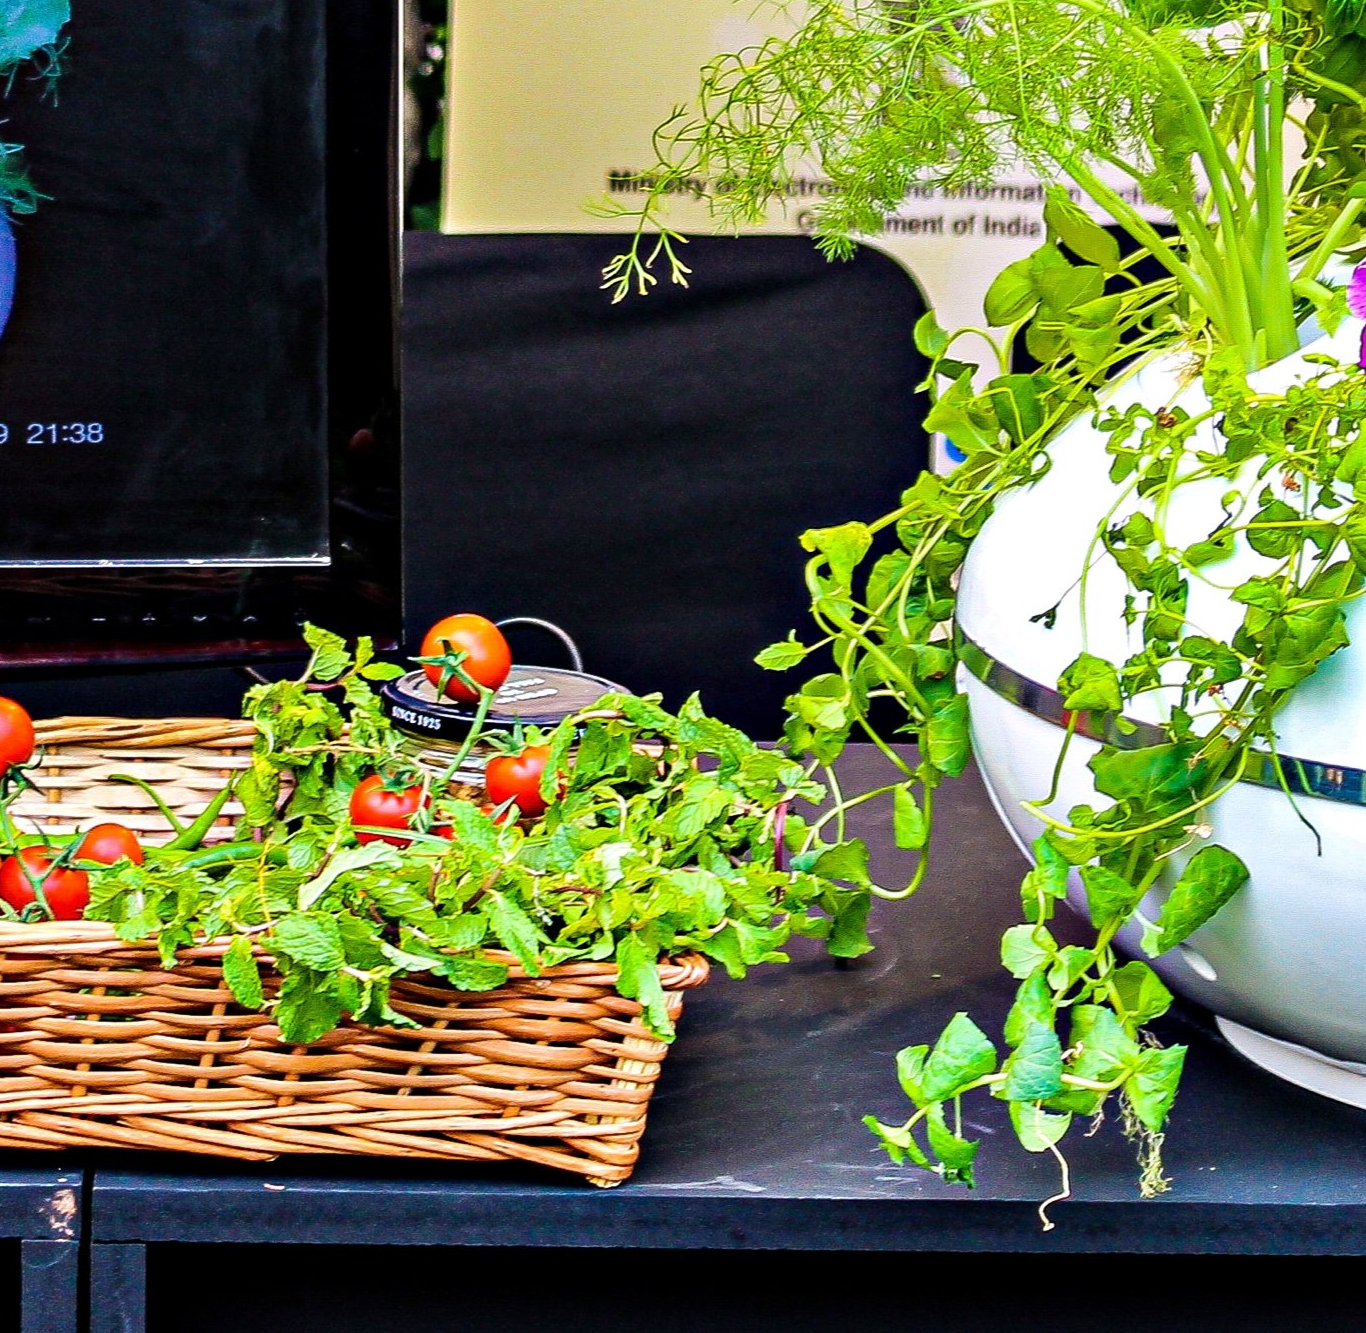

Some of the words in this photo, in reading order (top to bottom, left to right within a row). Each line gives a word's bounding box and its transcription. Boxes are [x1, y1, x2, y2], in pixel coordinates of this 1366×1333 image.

[953, 214, 975, 235] of
[984, 215, 1041, 237] India
[26, 423, 104, 445] 21:38
[392, 705, 417, 724] SINCE
[417, 714, 442, 730] 1925
